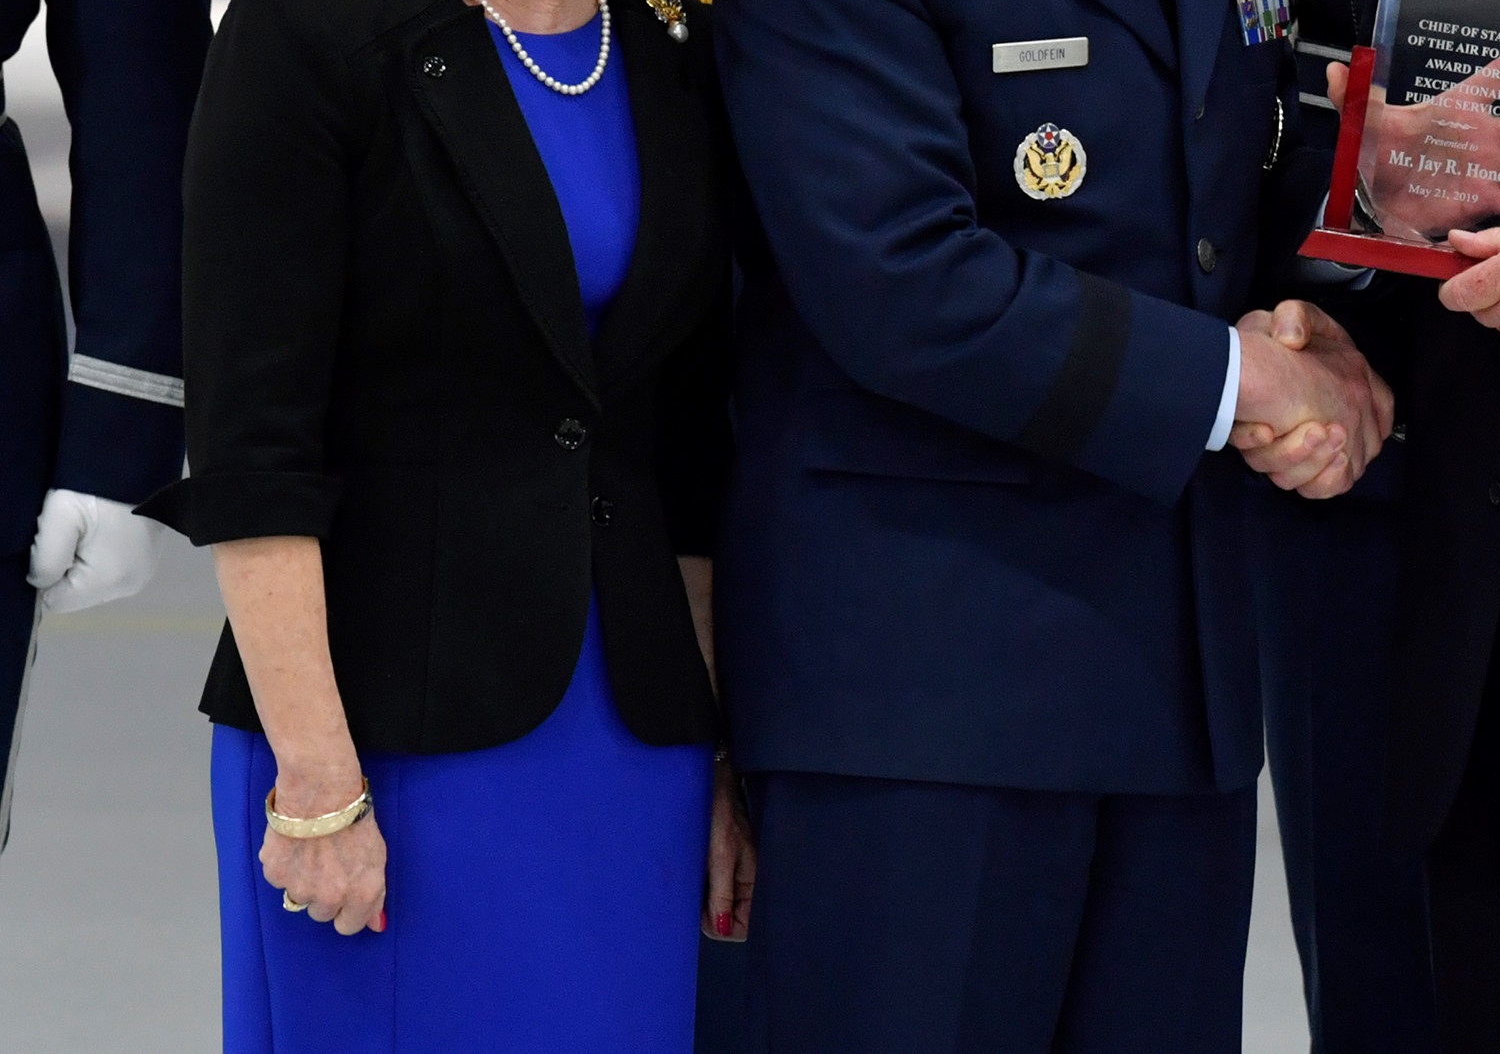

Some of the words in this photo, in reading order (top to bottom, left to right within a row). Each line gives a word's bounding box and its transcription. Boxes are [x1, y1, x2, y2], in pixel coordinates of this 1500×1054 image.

[1419, 19, 1459, 35] CHIEF
[1461, 26, 1479, 38] OF
[1407, 35, 1426, 46] OF
[1427, 37, 1454, 51] THE
[1456, 43, 1479, 56] AIR
[1019, 48, 1065, 63] GOLDFEIN
[1425, 58, 1471, 75] AWARD
[1474, 66, 1500, 79] FOR
[1405, 91, 1453, 107] PUBLIC
[1424, 135, 1468, 151] Presented
[1469, 143, 1478, 152] to
[1389, 150, 1413, 167] Mr.
[1417, 154, 1442, 176] Jay
[1445, 159, 1461, 175] R.
[1408, 184, 1432, 197] May
[1453, 192, 1478, 203] 2019
